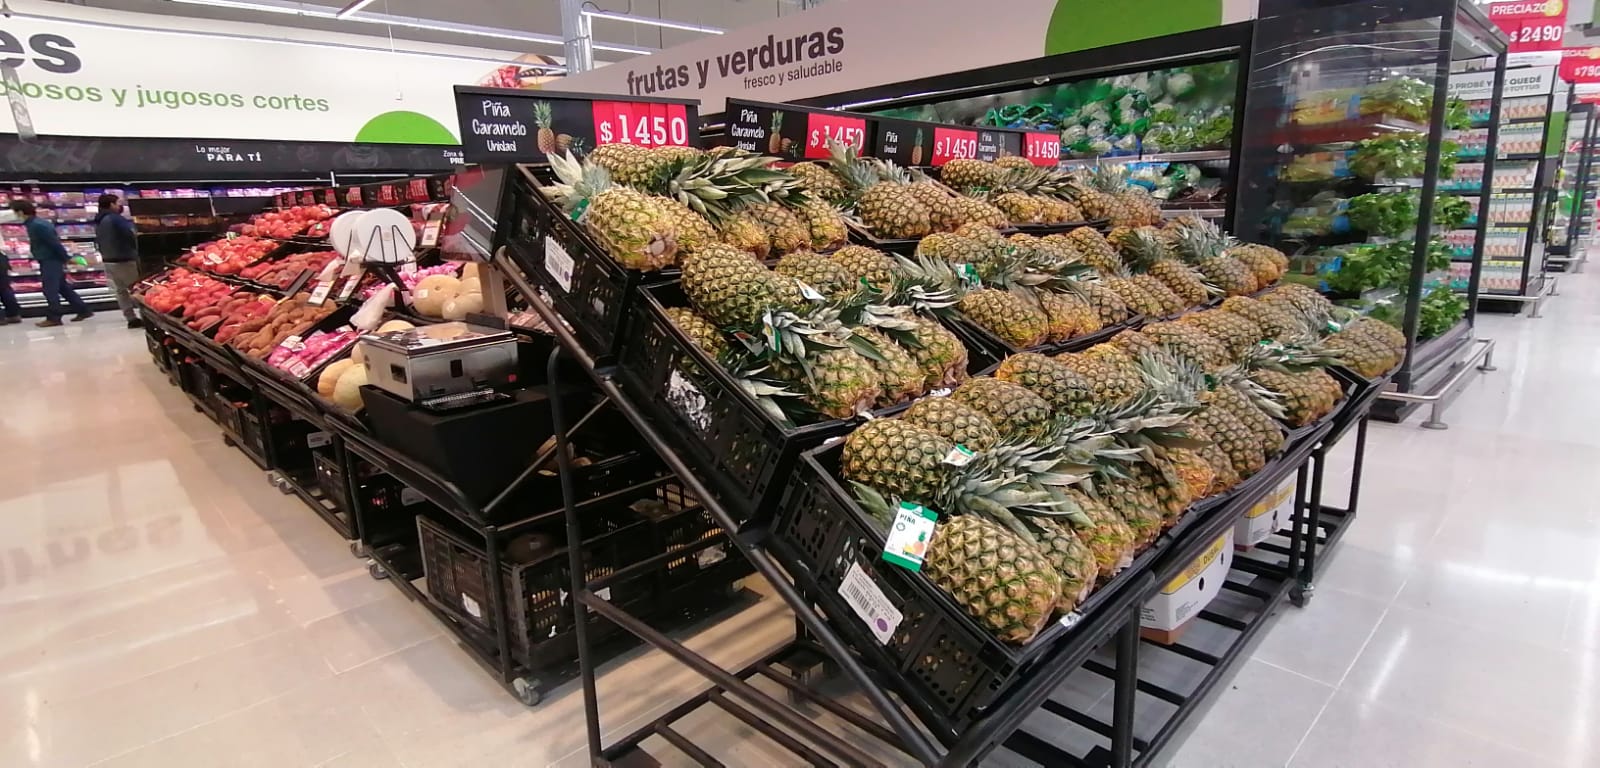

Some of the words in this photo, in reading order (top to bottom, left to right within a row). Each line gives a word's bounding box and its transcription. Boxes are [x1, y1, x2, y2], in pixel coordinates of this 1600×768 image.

[627, 64, 689, 95] frutas
[696, 58, 710, 89] y
[717, 27, 845, 78] verduras
[744, 74, 775, 89] fresco
[778, 73, 786, 86] y
[787, 59, 843, 81] saludable
[111, 88, 127, 107] y
[136, 84, 245, 109] jugosos
[253, 94, 330, 112] cortes
[483, 100, 511, 117] Piña
[740, 109, 758, 123] Piña
[472, 118, 527, 137] Caramelo
[731, 123, 765, 139] Caramelo
[487, 139, 517, 152] Unidad
[207, 153, 244, 161] PARA
